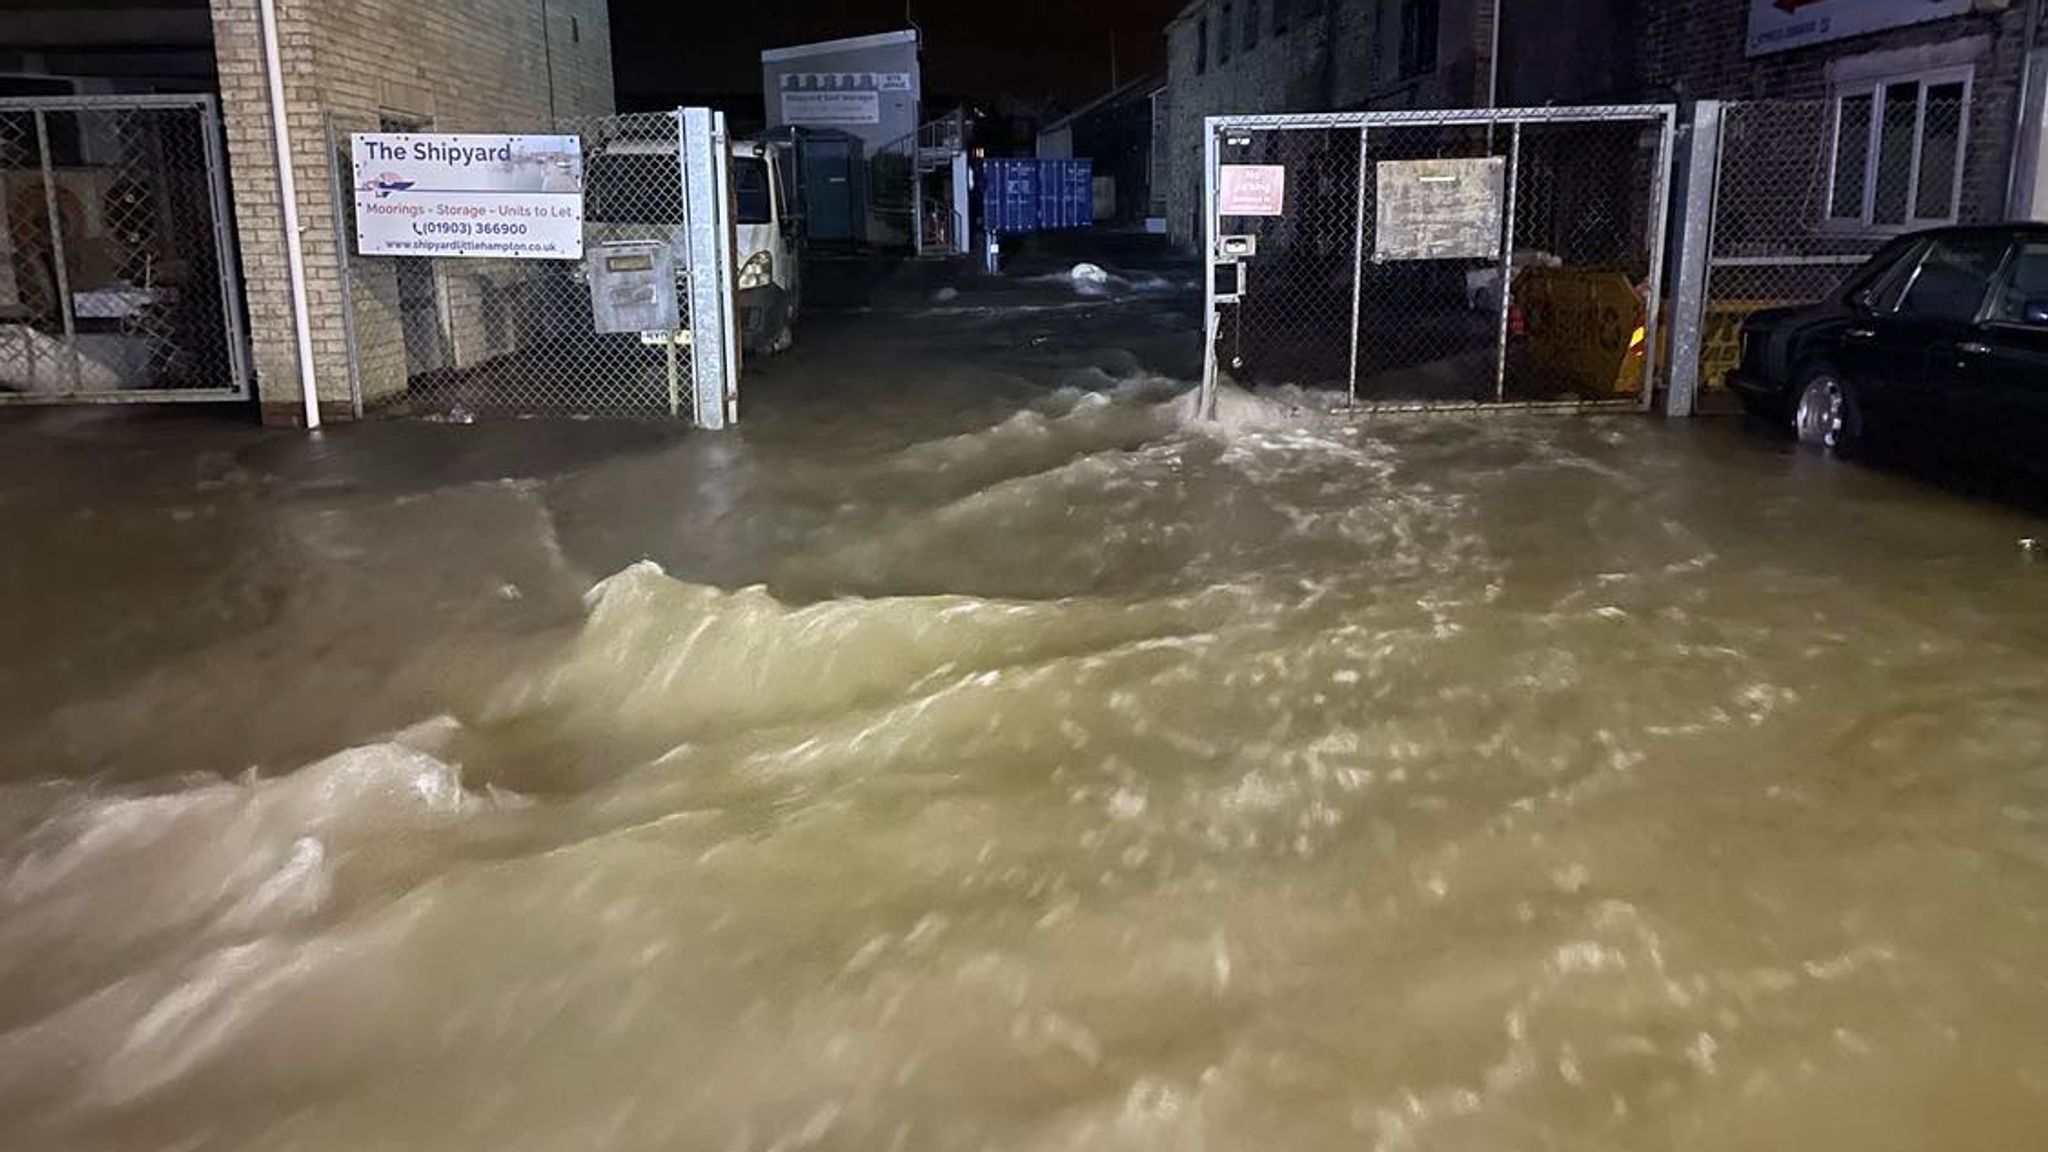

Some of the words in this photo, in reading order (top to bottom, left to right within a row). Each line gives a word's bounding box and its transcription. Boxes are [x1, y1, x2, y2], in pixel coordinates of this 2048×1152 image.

[364, 141, 408, 160] The
[413, 141, 511, 166] Shipyard
[366, 203, 425, 218] Moorings
[436, 204, 486, 219] Storage
[498, 205, 531, 217] Units
[534, 206, 548, 217] to
[551, 206, 572, 218] Let
[422, 222, 472, 235] (01903)
[475, 222, 528, 235] 366900
